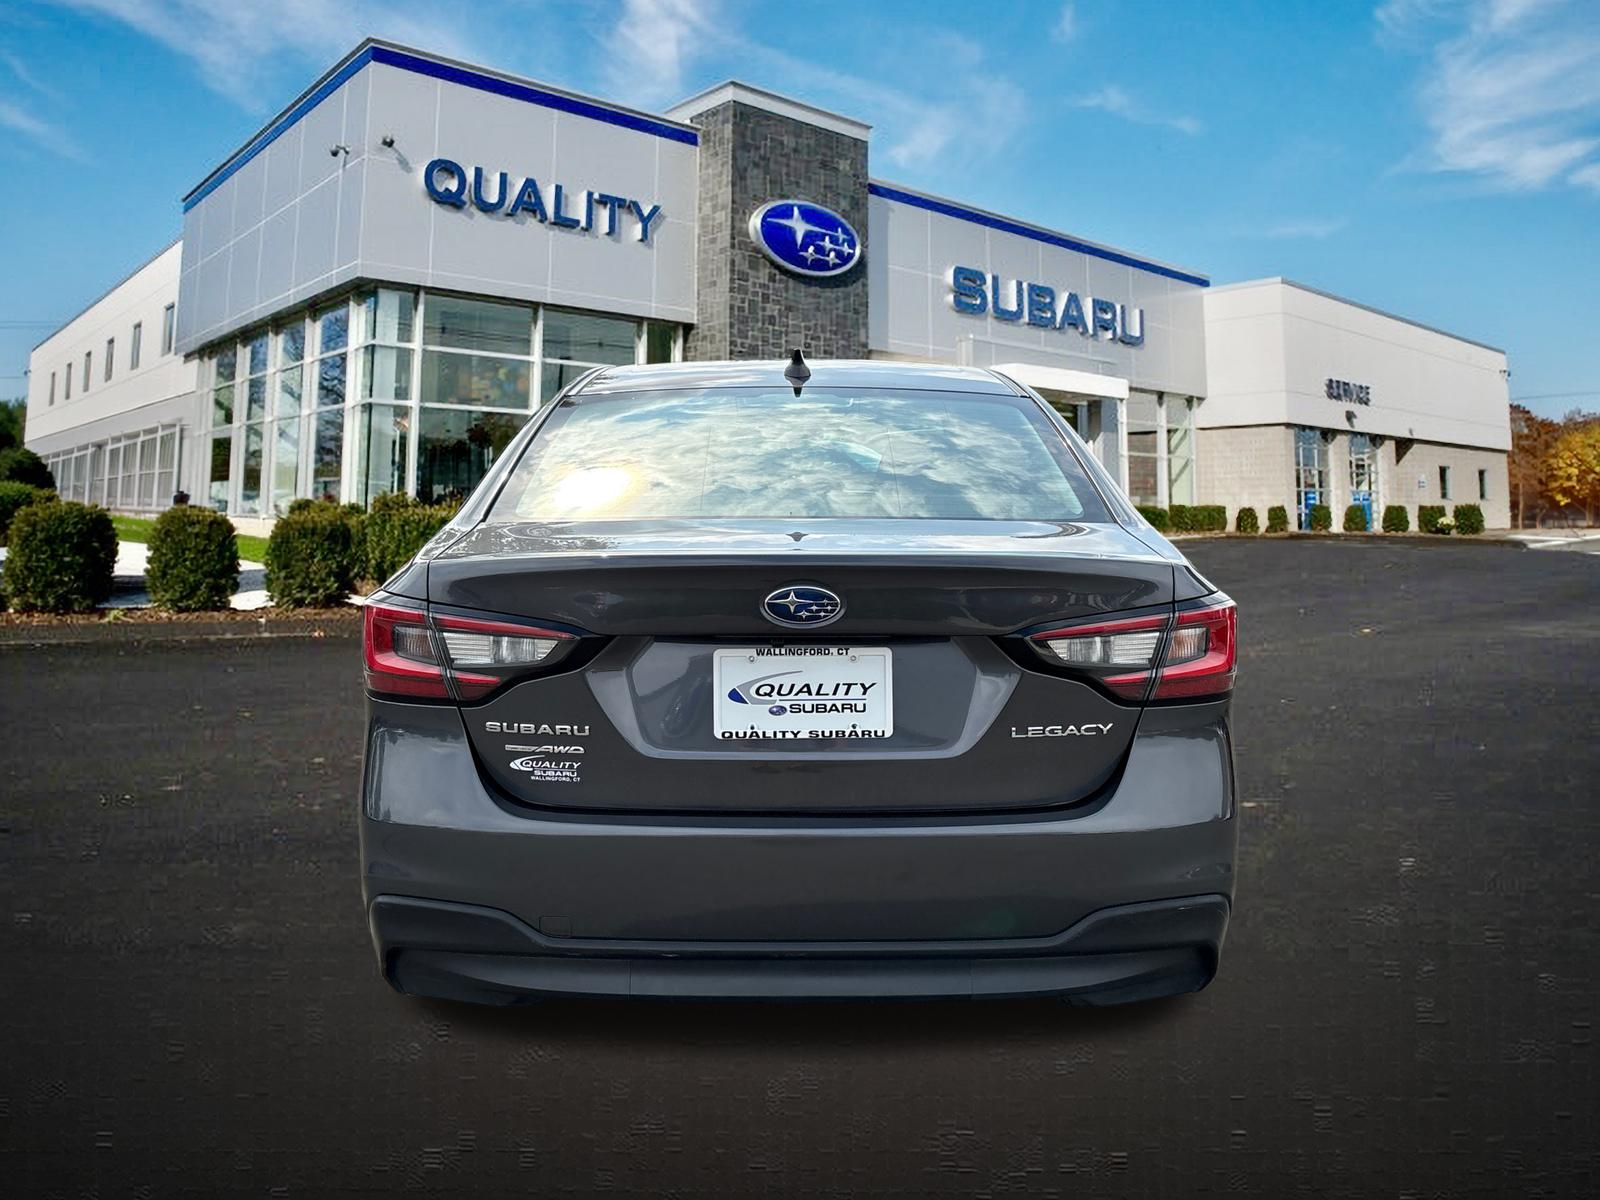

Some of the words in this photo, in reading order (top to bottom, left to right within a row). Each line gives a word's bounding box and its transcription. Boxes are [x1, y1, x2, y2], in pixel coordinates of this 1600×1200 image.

[424, 158, 661, 243] QUALITY
[951, 265, 1145, 346] SUBARU
[755, 648, 834, 656] WALLINGFORD,
[837, 648, 850, 656] CT
[754, 682, 877, 697] QUALITY
[789, 703, 867, 713] SUBARU
[485, 721, 590, 736] SUBARU
[721, 730, 801, 739] QUALITY
[808, 730, 886, 738] SUBARU
[1011, 723, 1114, 738] LEGACY
[534, 745, 585, 754] AWD
[522, 760, 581, 769] QUALITY
